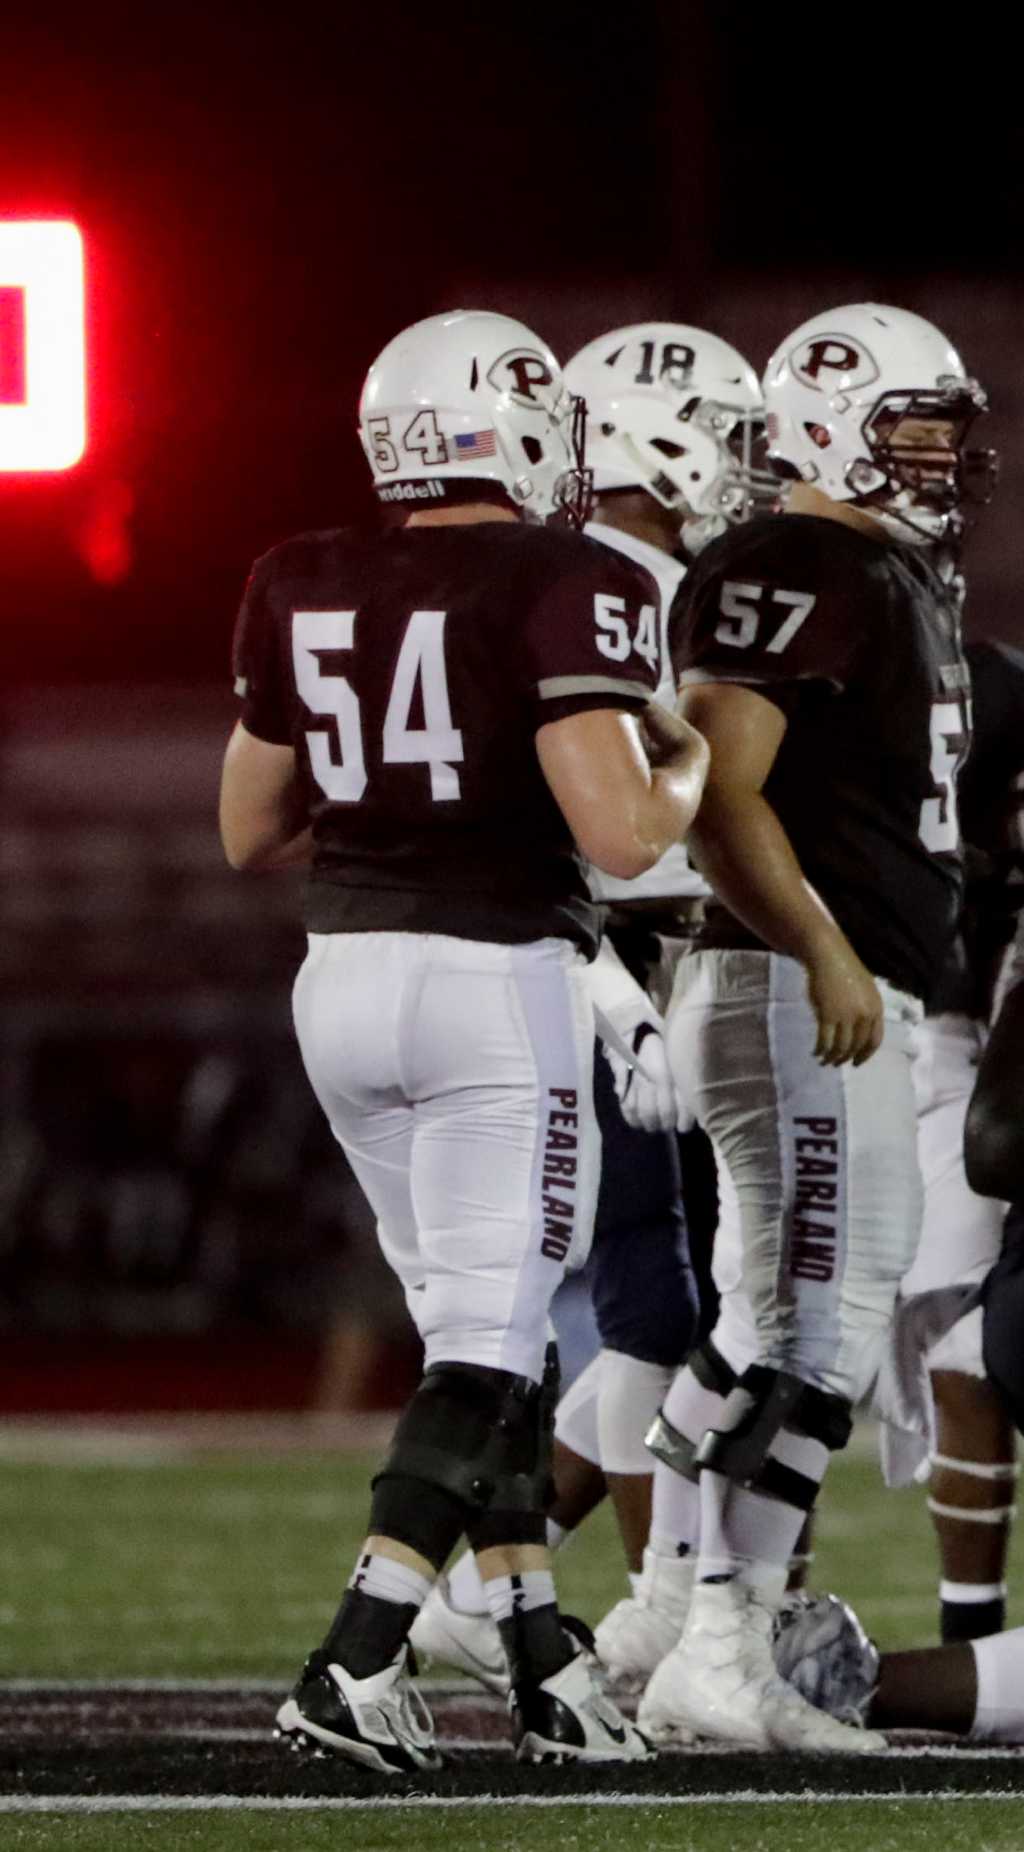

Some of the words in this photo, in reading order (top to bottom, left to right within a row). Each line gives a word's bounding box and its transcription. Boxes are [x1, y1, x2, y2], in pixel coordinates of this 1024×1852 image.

[634, 341, 696, 391] 18
[367, 409, 449, 474] 54
[594, 592, 659, 672] 54
[714, 580, 817, 655] 57
[292, 610, 464, 802] 54
[542, 1088, 577, 1262] PEARLAND
[789, 1117, 838, 1282] PEARLAND
